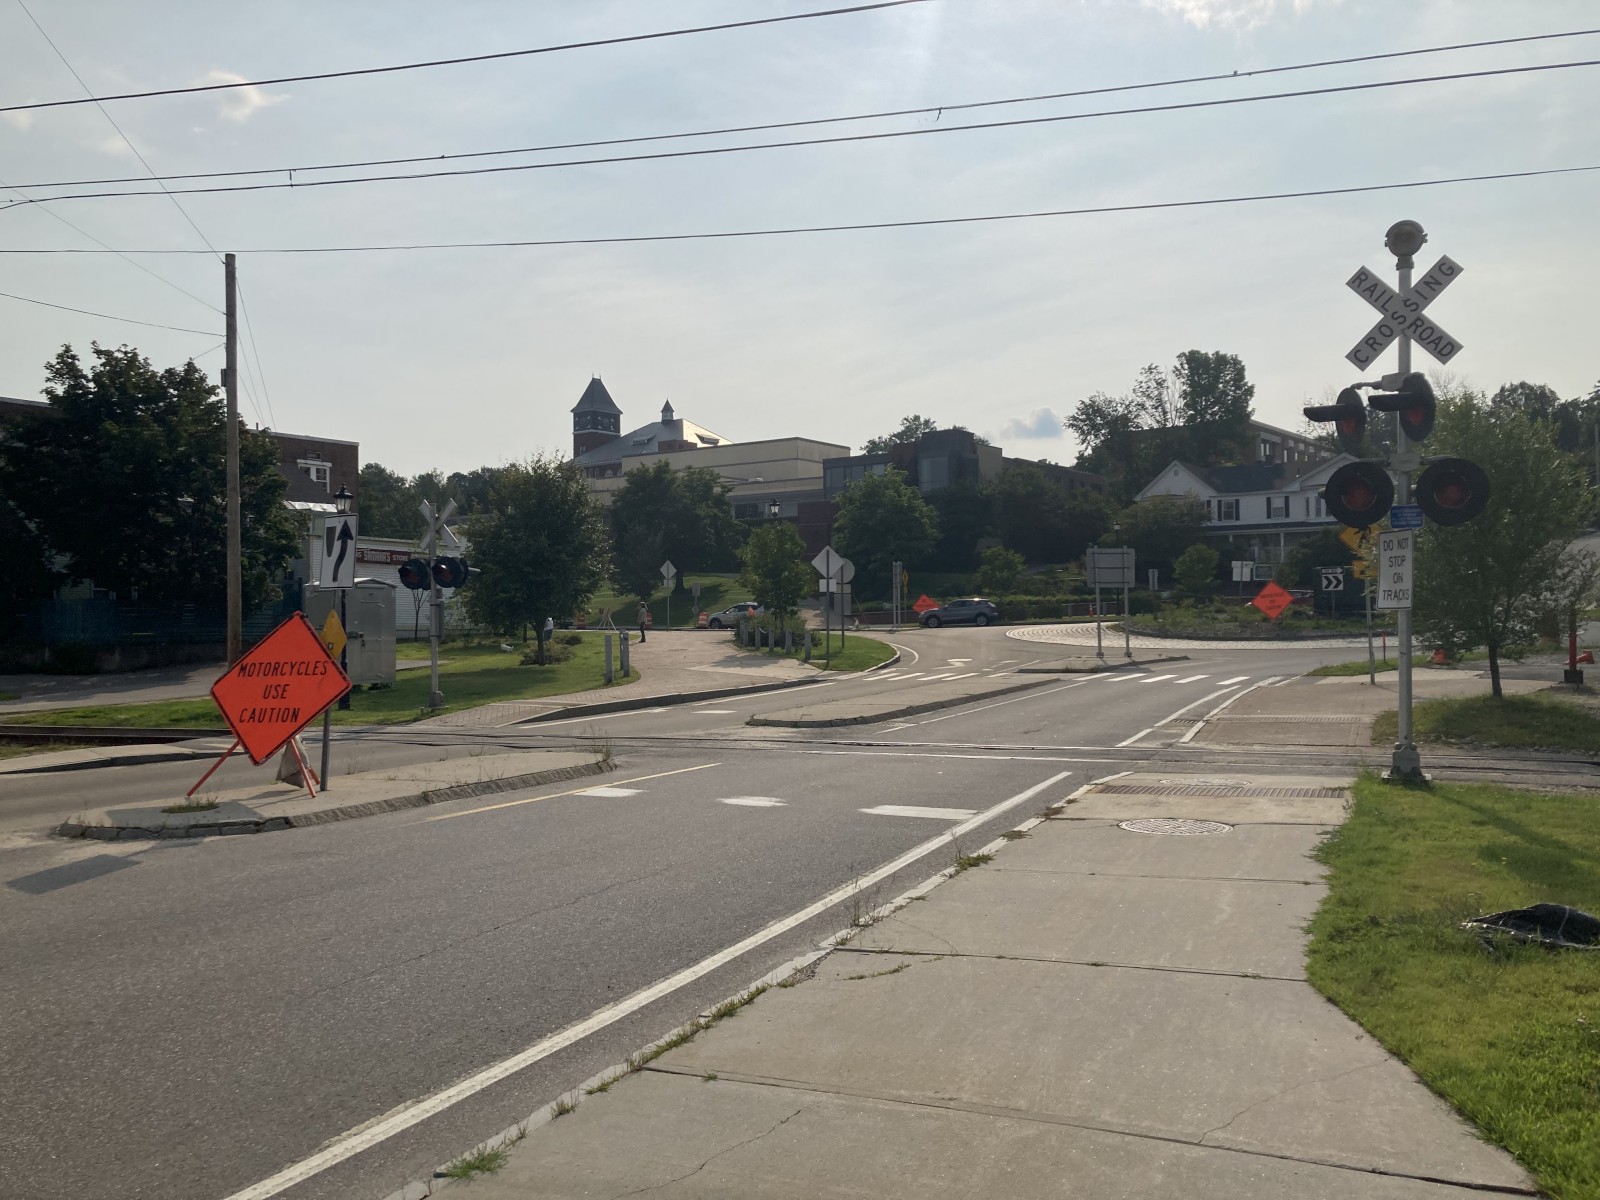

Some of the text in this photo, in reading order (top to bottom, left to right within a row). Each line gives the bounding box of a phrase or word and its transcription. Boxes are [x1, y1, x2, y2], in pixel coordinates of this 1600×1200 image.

[1353, 262, 1455, 364] CROSSING
[1383, 537, 1410, 552] DO NOT
[392, 554, 409, 562] STORE
[1388, 555, 1406, 568] STOP
[1392, 572, 1404, 584] ON
[1382, 588, 1410, 601] TRACKS
[237, 660, 329, 678] MOTORCYCLES
[263, 683, 290, 700] USE
[239, 707, 301, 723] CAUTION
